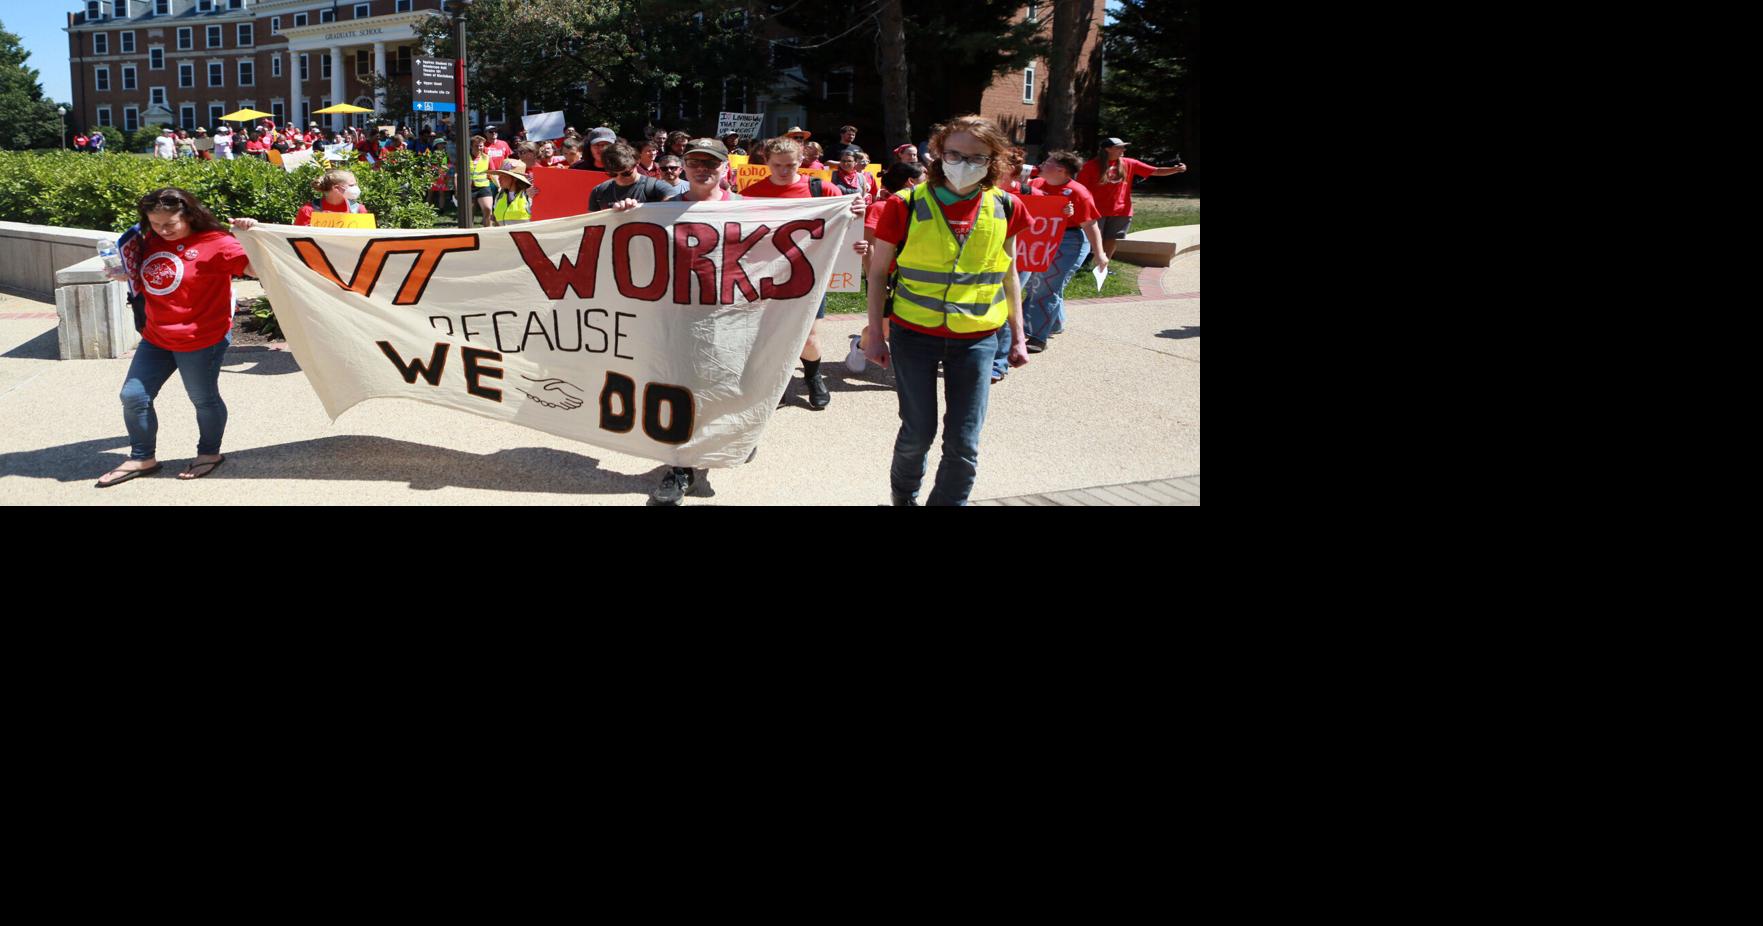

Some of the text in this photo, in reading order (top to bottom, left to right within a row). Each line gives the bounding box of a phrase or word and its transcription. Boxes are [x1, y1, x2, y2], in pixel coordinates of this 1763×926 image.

[325, 28, 384, 40] GRADUATE SCHOOL
[287, 218, 825, 305] VT WORKS
[1016, 240, 1058, 267] ACK
[829, 272, 855, 289] ER
[375, 341, 695, 445] WE DO
